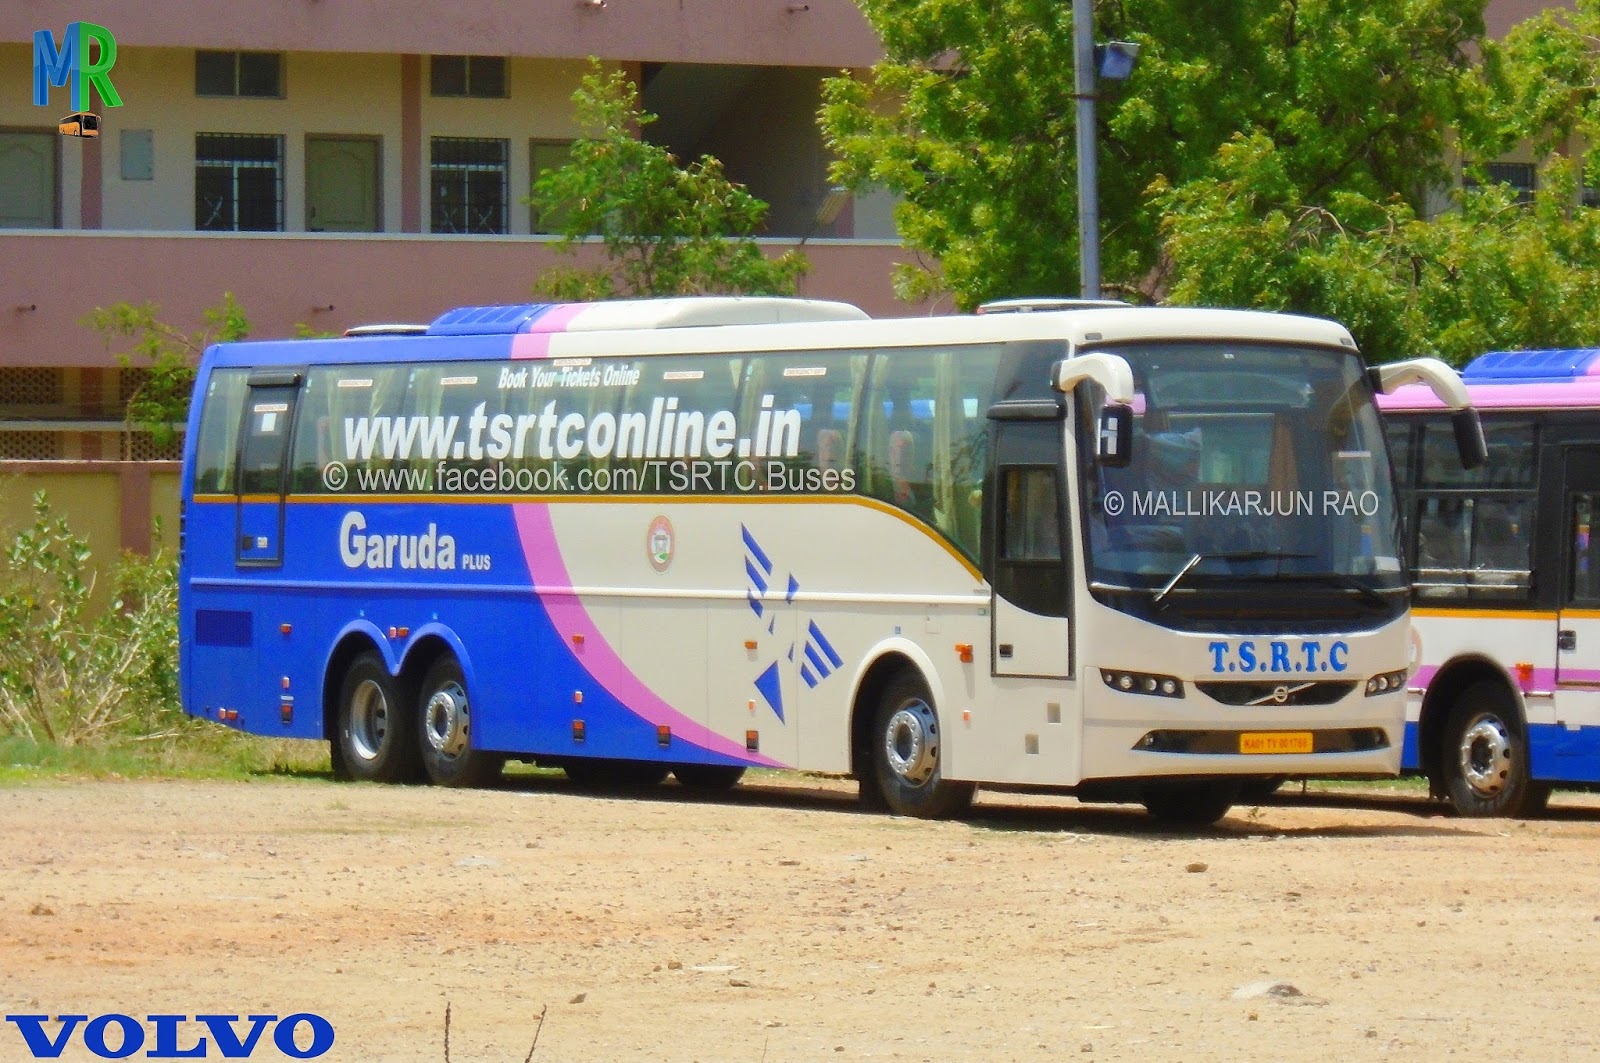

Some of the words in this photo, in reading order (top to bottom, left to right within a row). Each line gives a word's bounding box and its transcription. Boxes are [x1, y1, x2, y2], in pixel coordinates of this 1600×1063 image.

[498, 366, 528, 388] Book
[531, 365, 557, 388] Your
[560, 366, 601, 387] Tickets
[603, 364, 640, 386] Online
[344, 394, 801, 460] www.tsrtconline.in
[339, 511, 455, 570] Garuda
[462, 554, 491, 571] PLUS
[1208, 641, 1349, 673] T.S.R.T.C
